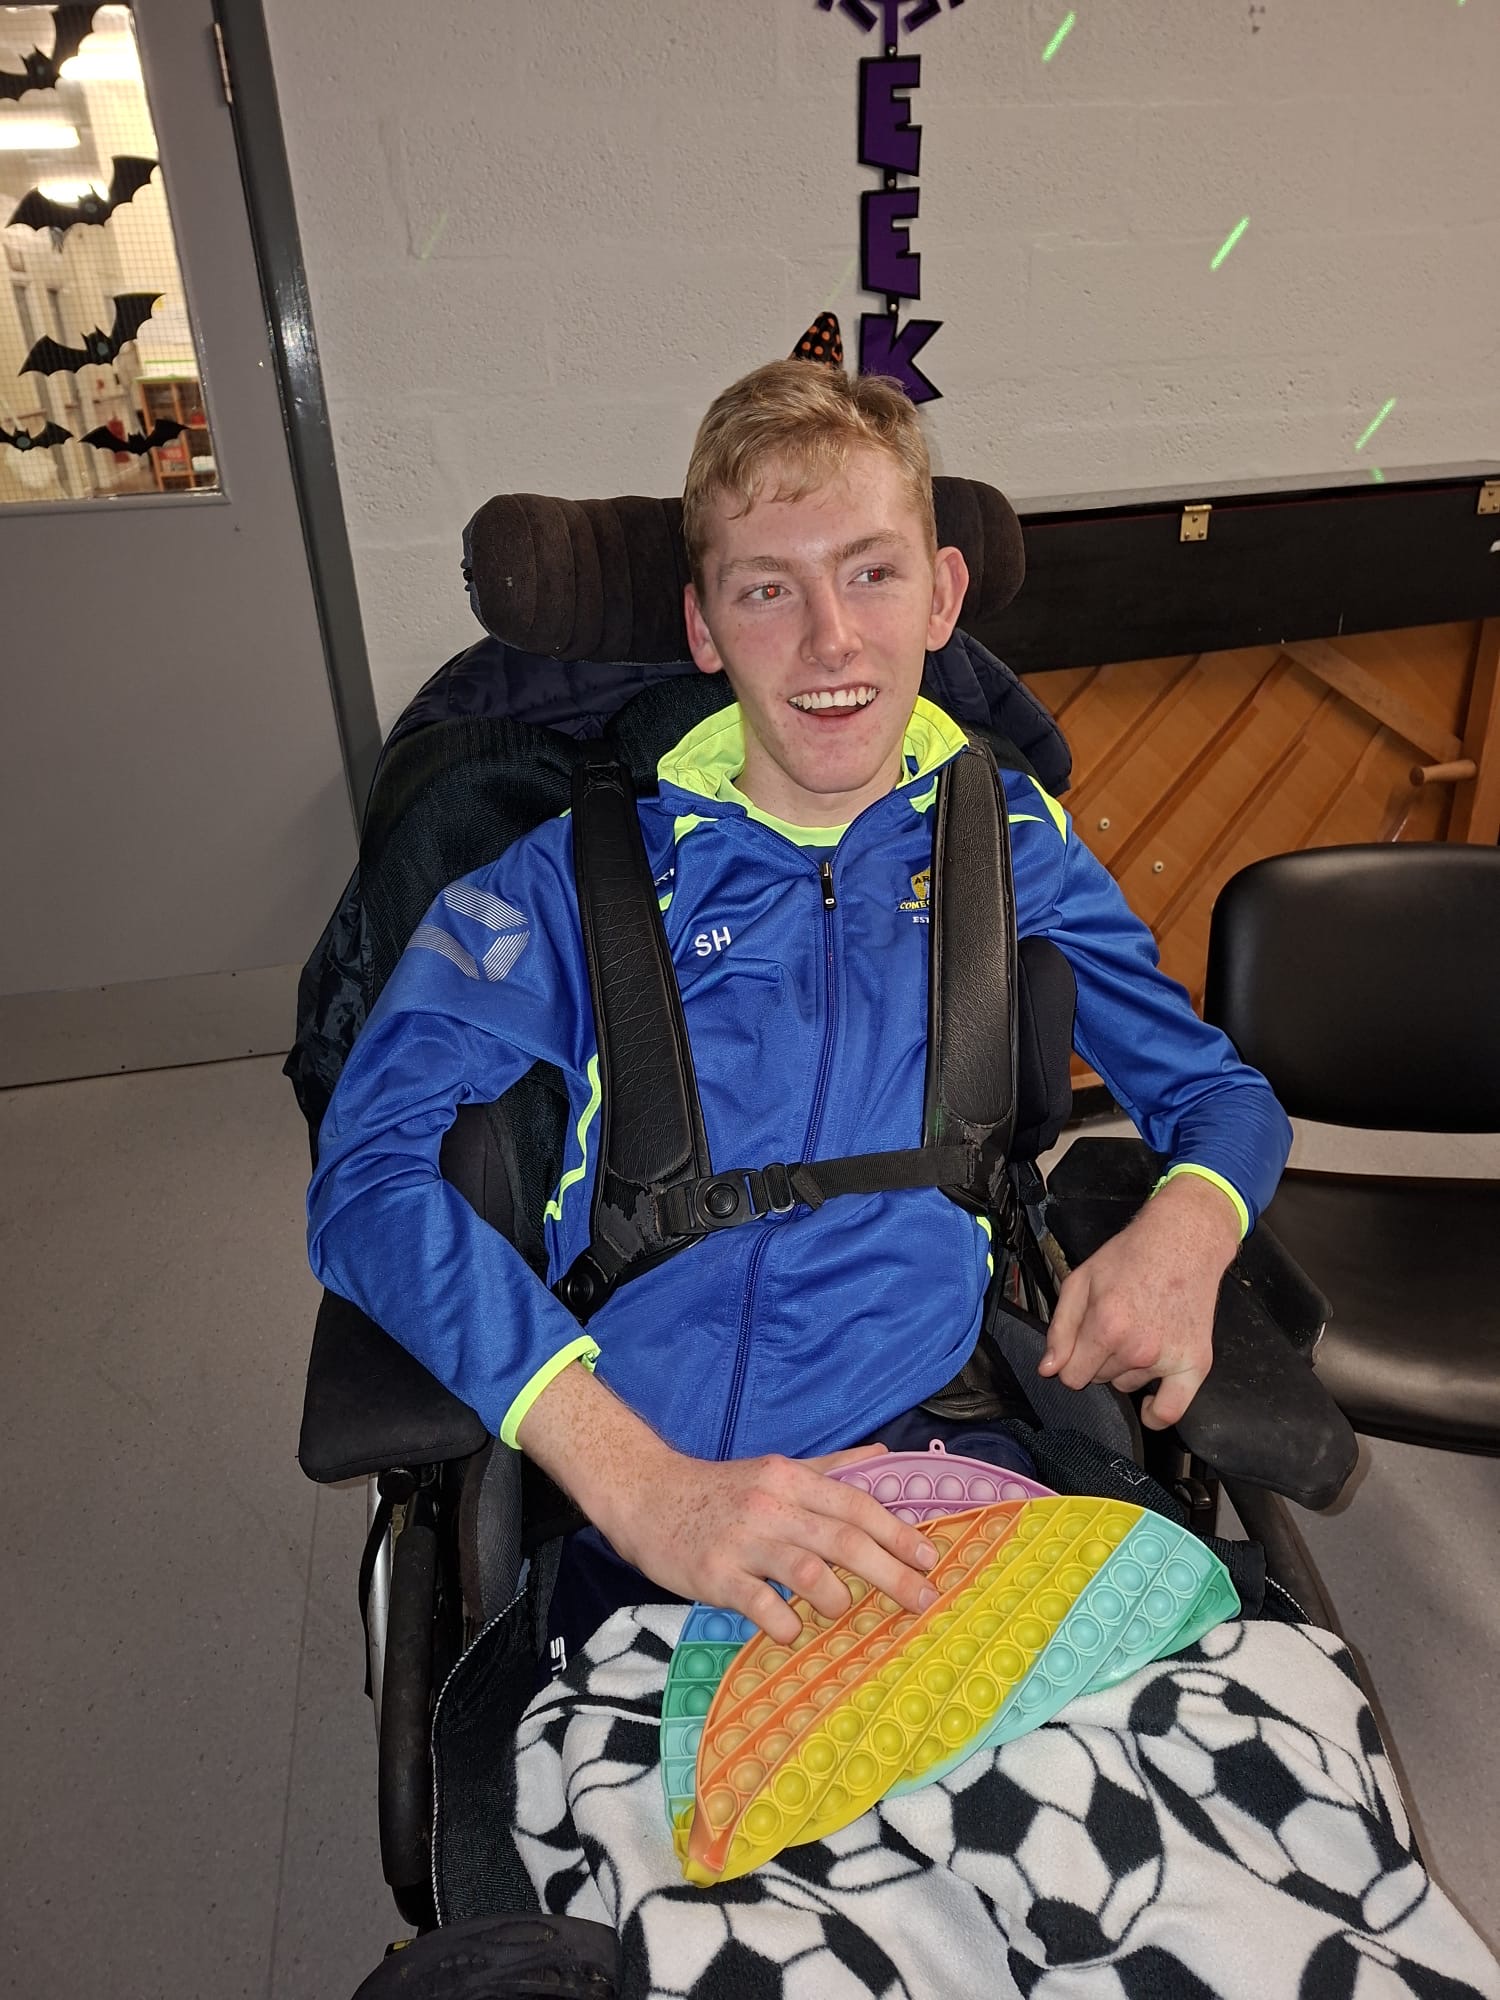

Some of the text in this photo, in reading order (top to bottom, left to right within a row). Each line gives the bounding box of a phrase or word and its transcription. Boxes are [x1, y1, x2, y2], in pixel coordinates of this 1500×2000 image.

[858, 54, 944, 405] EEK
[899, 899, 930, 910] COME
[694, 926, 731, 957] SH
